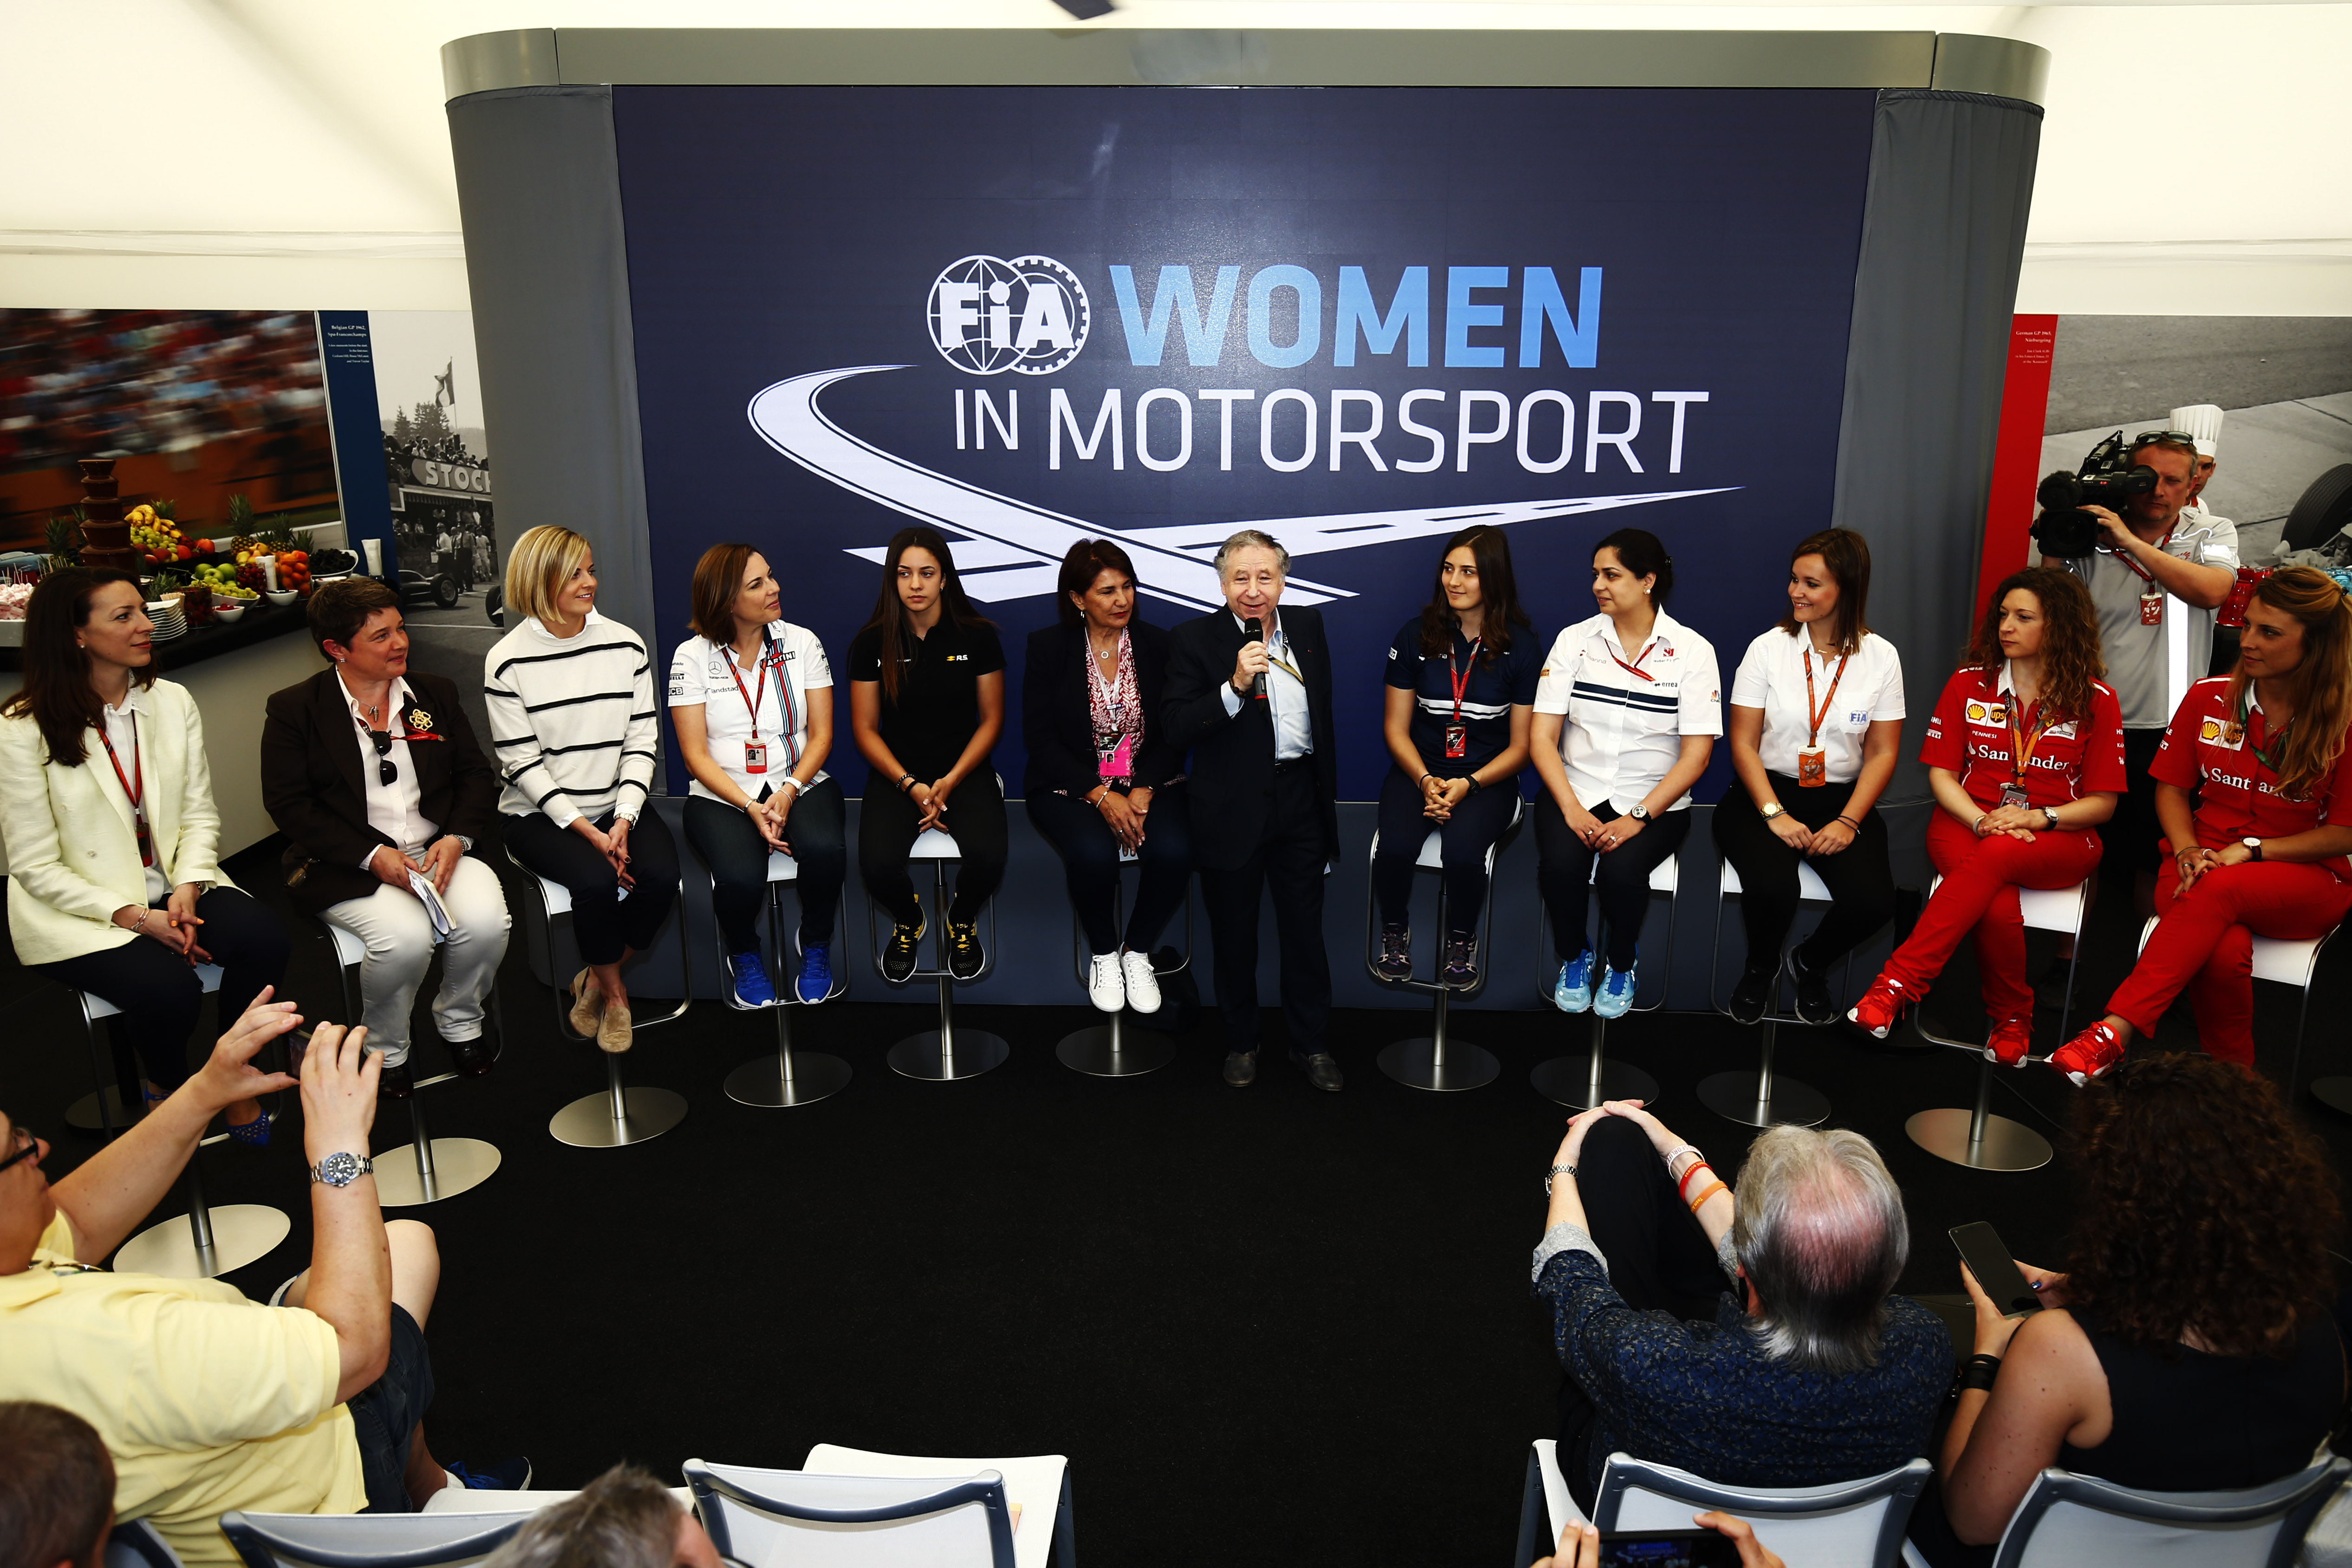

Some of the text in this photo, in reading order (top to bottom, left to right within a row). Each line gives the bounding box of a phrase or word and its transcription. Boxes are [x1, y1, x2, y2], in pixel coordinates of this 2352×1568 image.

[1109, 265, 1602, 368] WOMEN
[955, 388, 1709, 473] IN MOTORSPORT
[760, 651, 795, 666] ARTINI
[1972, 730, 1997, 739] PENNESI
